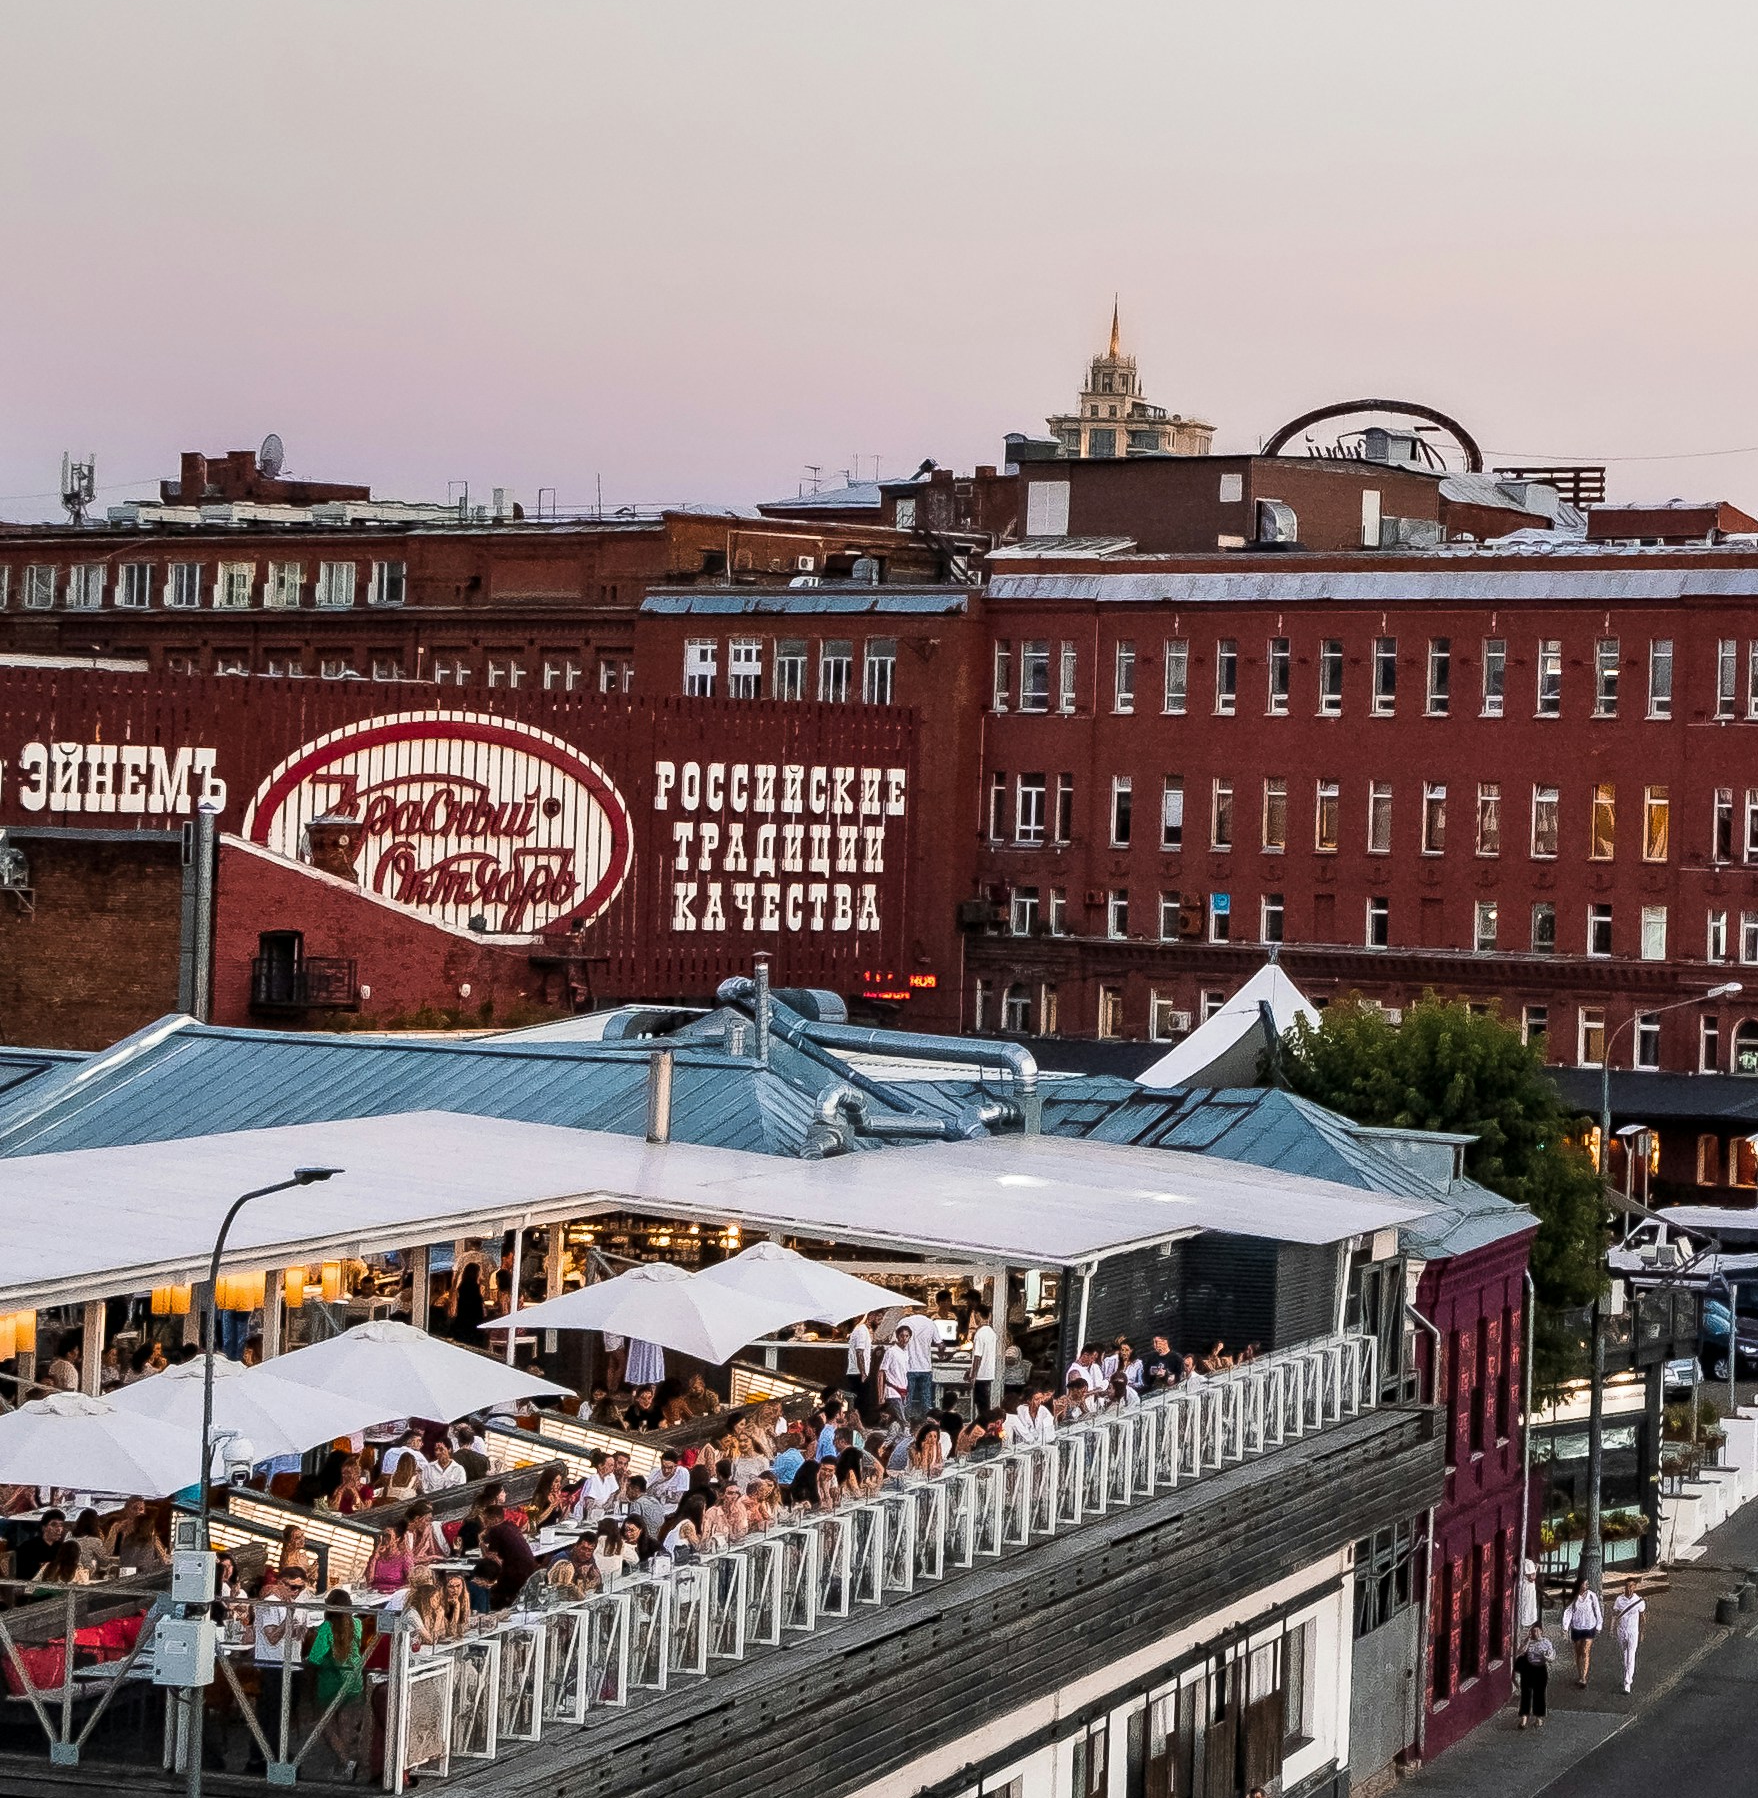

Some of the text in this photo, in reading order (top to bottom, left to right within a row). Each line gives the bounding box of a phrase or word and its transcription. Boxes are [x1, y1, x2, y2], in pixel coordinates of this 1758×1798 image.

[20, 742, 227, 814] ЭЙНЕМЪ
[654, 761, 906, 815] РОССИЙСКИЕ
[673, 822, 885, 878] ТРАДИЦИИ
[373, 841, 581, 932] Октябрь
[672, 882, 882, 931] КАЧЕСТВА
